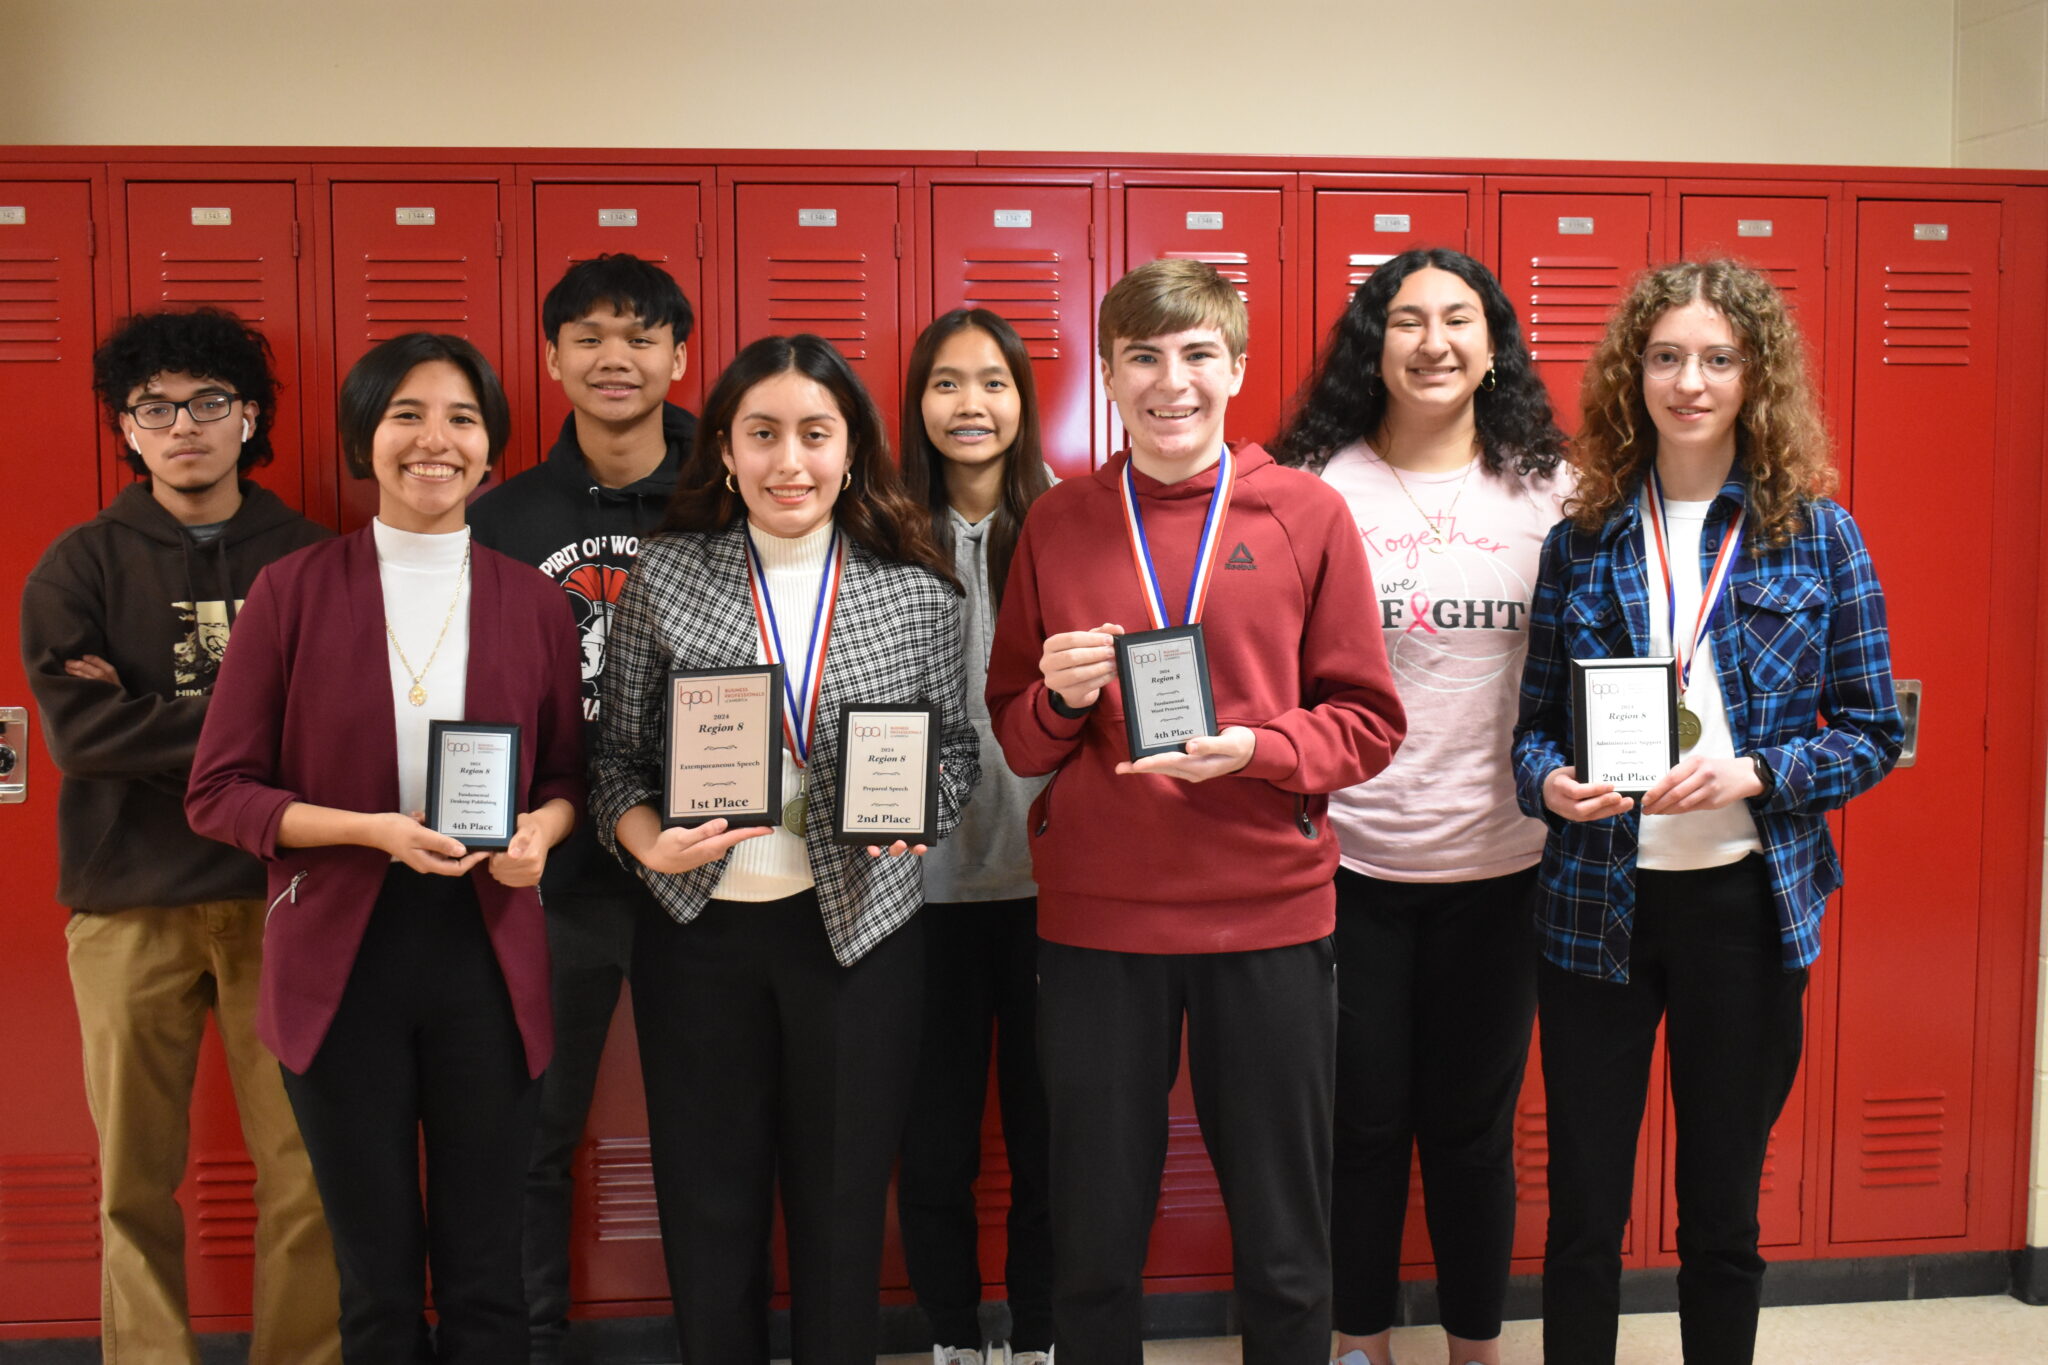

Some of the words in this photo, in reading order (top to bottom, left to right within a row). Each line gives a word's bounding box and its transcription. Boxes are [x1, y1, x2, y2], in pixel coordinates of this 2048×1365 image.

[539, 543, 580, 578] PIRIT
[1381, 578, 1417, 594] we
[1151, 676, 1174, 684] Region
[1608, 712, 1639, 721] Region
[699, 723, 734, 735] Region
[737, 722, 744, 731] 8
[1154, 730, 1169, 739] 4th
[1171, 728, 1194, 737] Place
[868, 755, 898, 764] Region
[680, 762, 735, 771] Extemporaneous
[737, 760, 760, 768] Speech
[460, 767, 484, 775] Region
[1602, 773, 1624, 782] 2nd
[1628, 773, 1657, 782] Place
[691, 799, 710, 809] 1st
[714, 797, 749, 808] Place
[857, 814, 878, 823] 2nd
[882, 814, 911, 824] Place
[452, 822, 467, 830] 4th
[470, 822, 494, 831] Place
